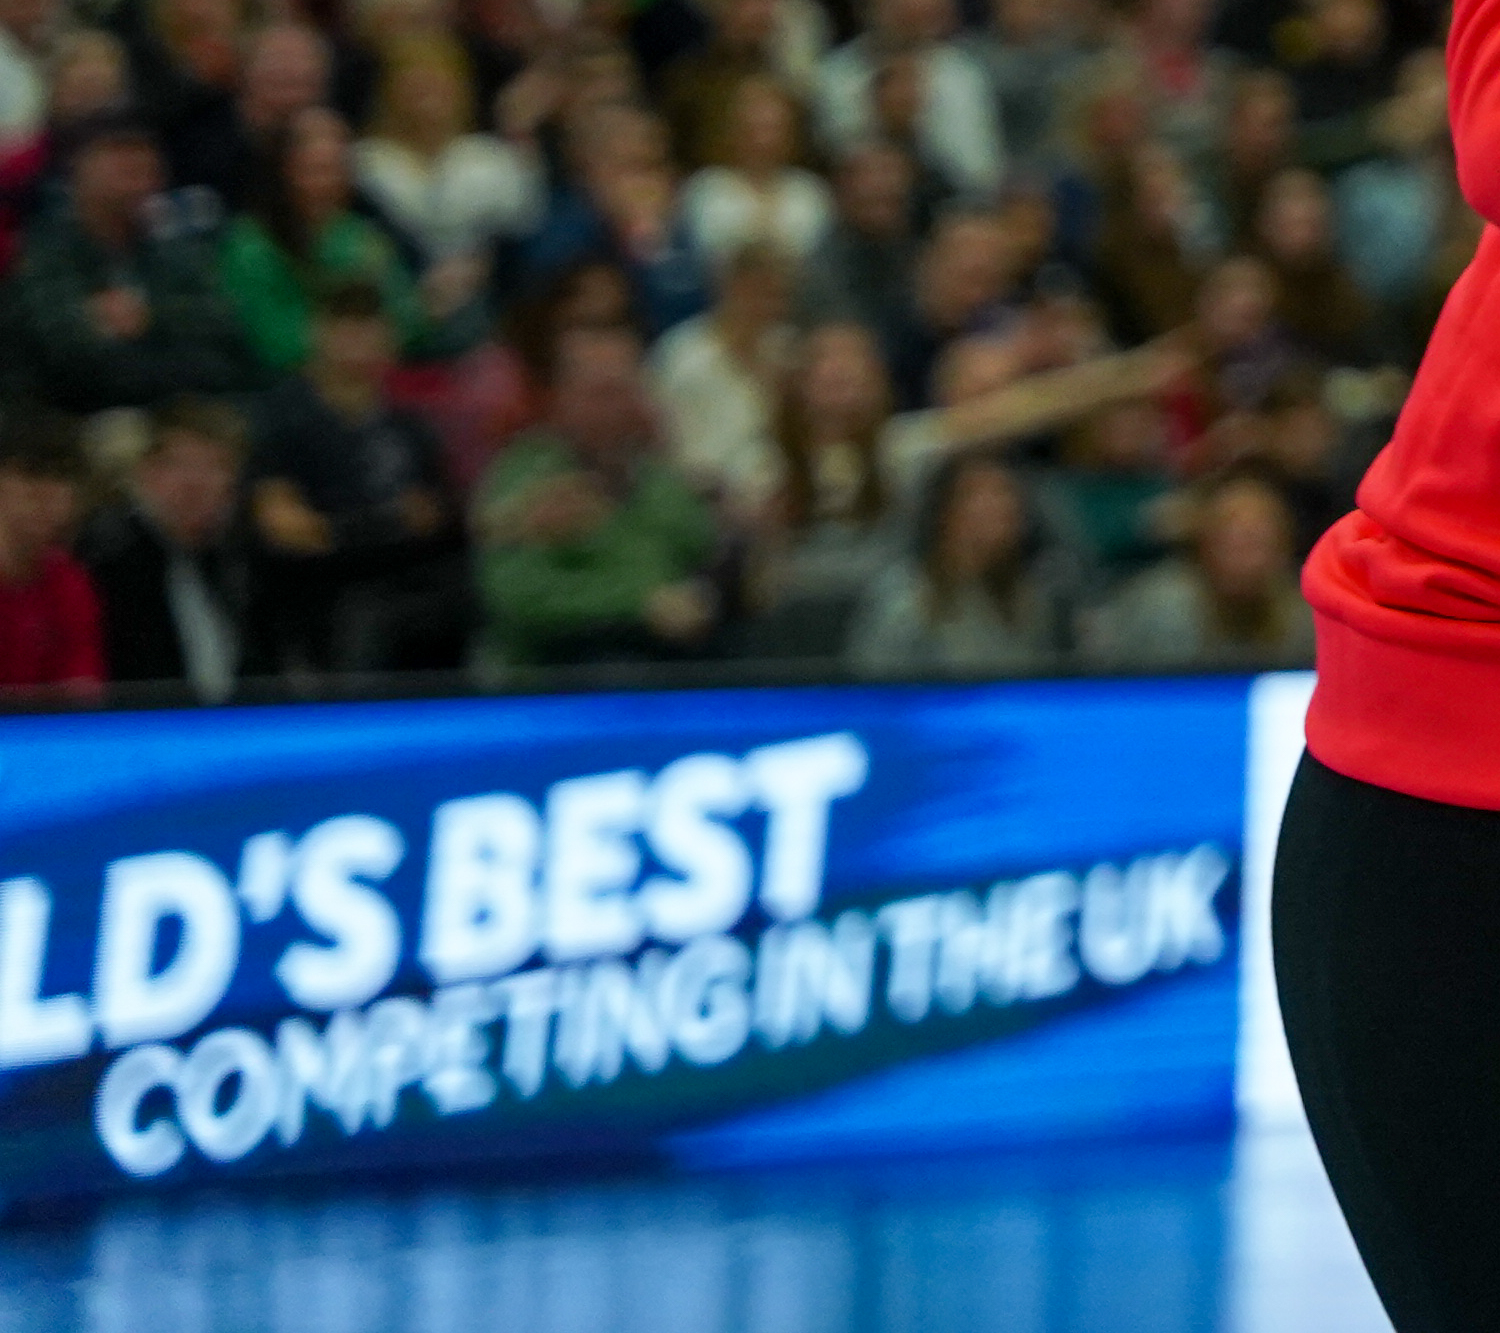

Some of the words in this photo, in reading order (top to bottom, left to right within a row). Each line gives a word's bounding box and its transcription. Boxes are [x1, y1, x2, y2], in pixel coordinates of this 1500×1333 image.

[418, 731, 872, 983] BEST
[94, 937, 755, 1178] COMPETING
[757, 907, 870, 1049] IN
[880, 867, 1080, 1026] THE
[1078, 841, 1236, 983] UK
